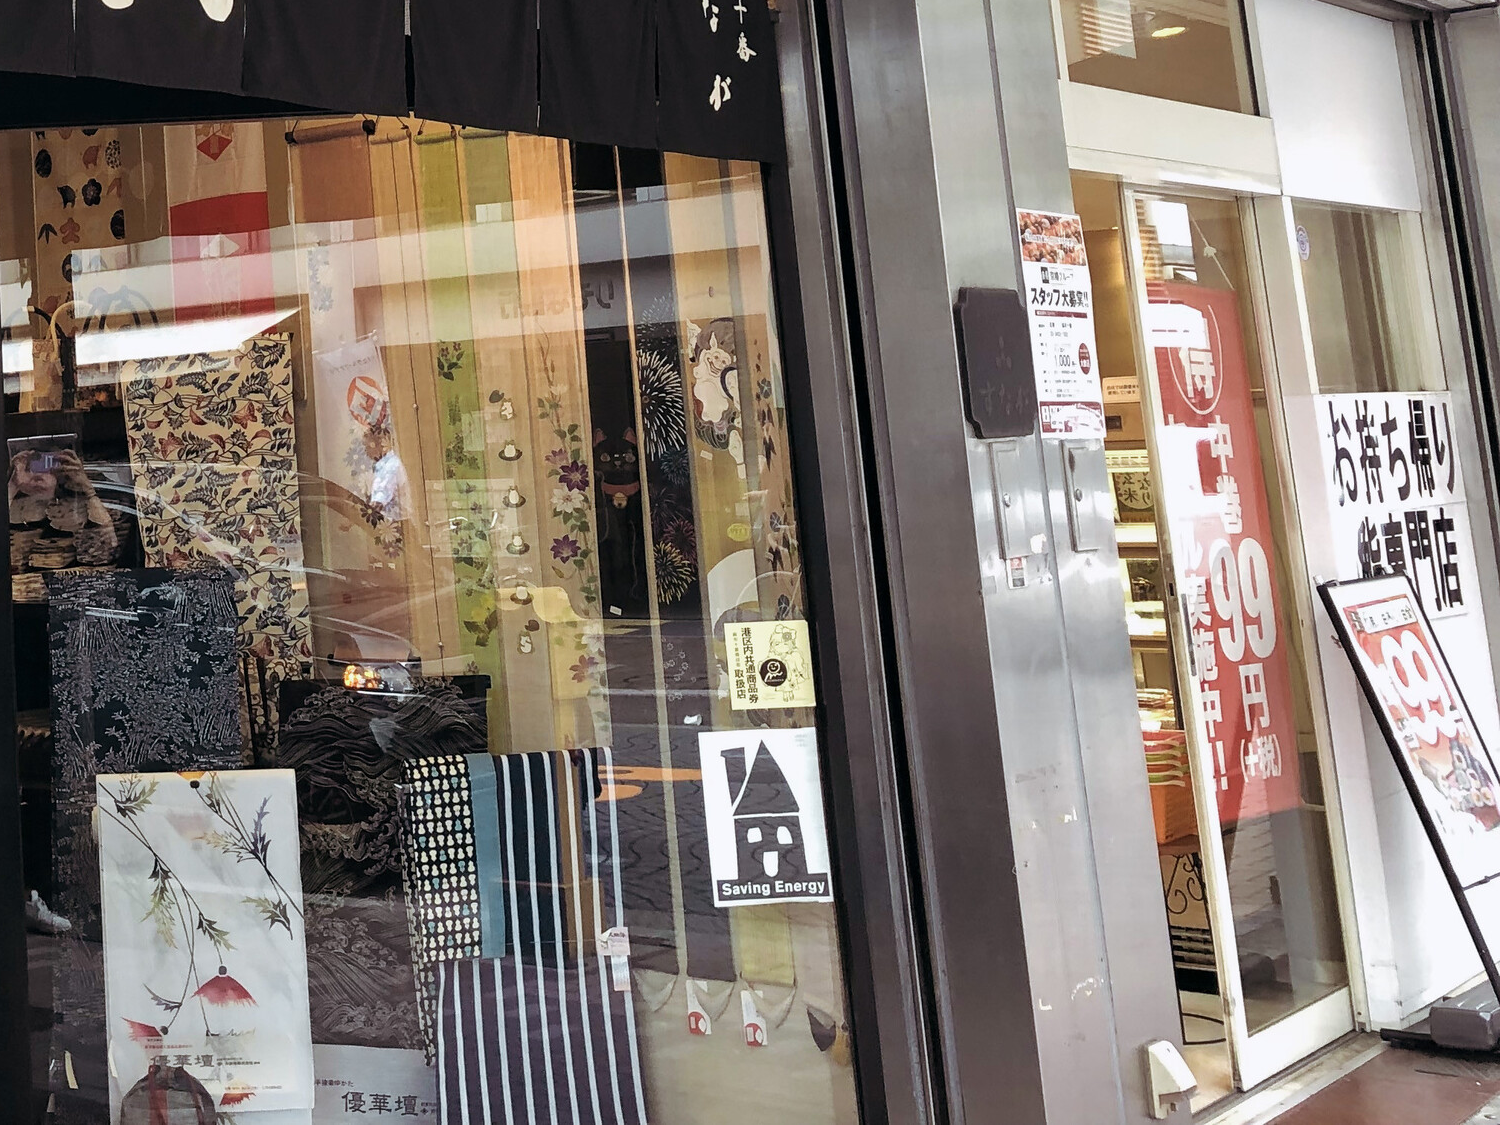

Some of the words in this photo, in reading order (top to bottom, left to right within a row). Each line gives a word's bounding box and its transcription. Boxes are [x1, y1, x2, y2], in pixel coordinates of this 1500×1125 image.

[1327, 398, 1455, 507] お持ち帰り
[741, 627, 759, 704] 港区内共通商品券
[734, 669, 747, 700] 取扱店
[721, 881, 771, 897] Saving
[774, 878, 826, 895] Energy
[341, 1091, 419, 1116] 優華壇
